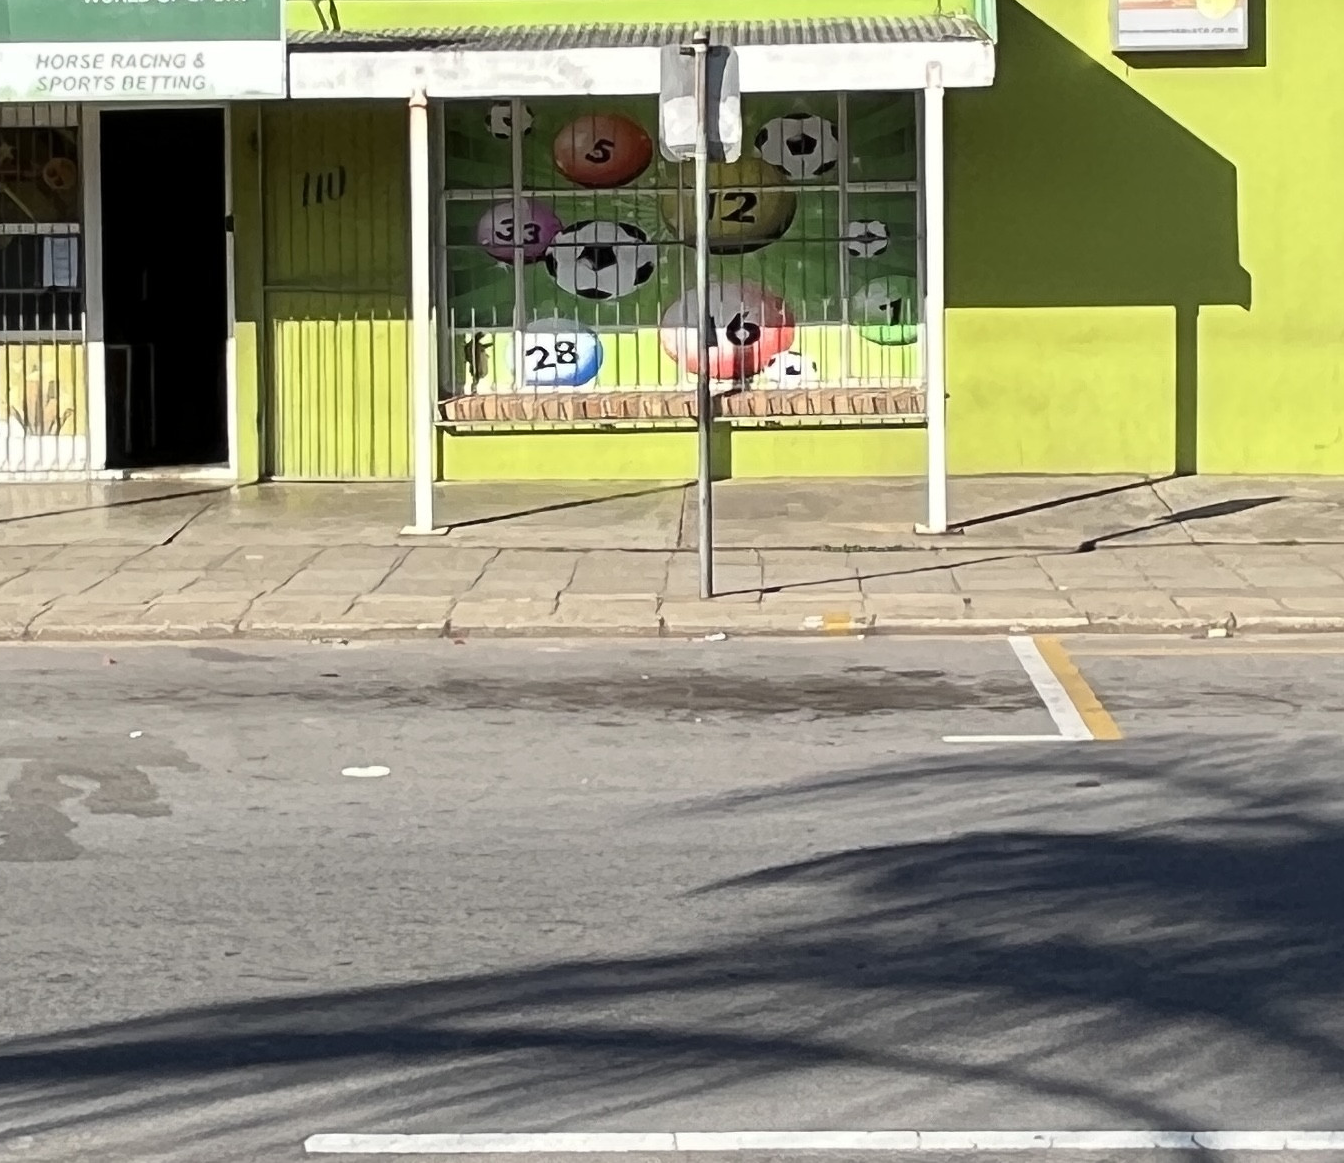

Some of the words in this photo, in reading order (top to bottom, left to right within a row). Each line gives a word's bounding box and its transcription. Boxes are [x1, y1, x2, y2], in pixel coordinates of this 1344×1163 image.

[36, 54, 104, 69] HORSE
[111, 53, 186, 69] RACING
[193, 52, 205, 69] &
[37, 76, 114, 91] SPORTS
[122, 75, 205, 91] BETTING
[585, 139, 615, 163] 5
[495, 219, 541, 245] 33
[526, 341, 578, 371] 28
